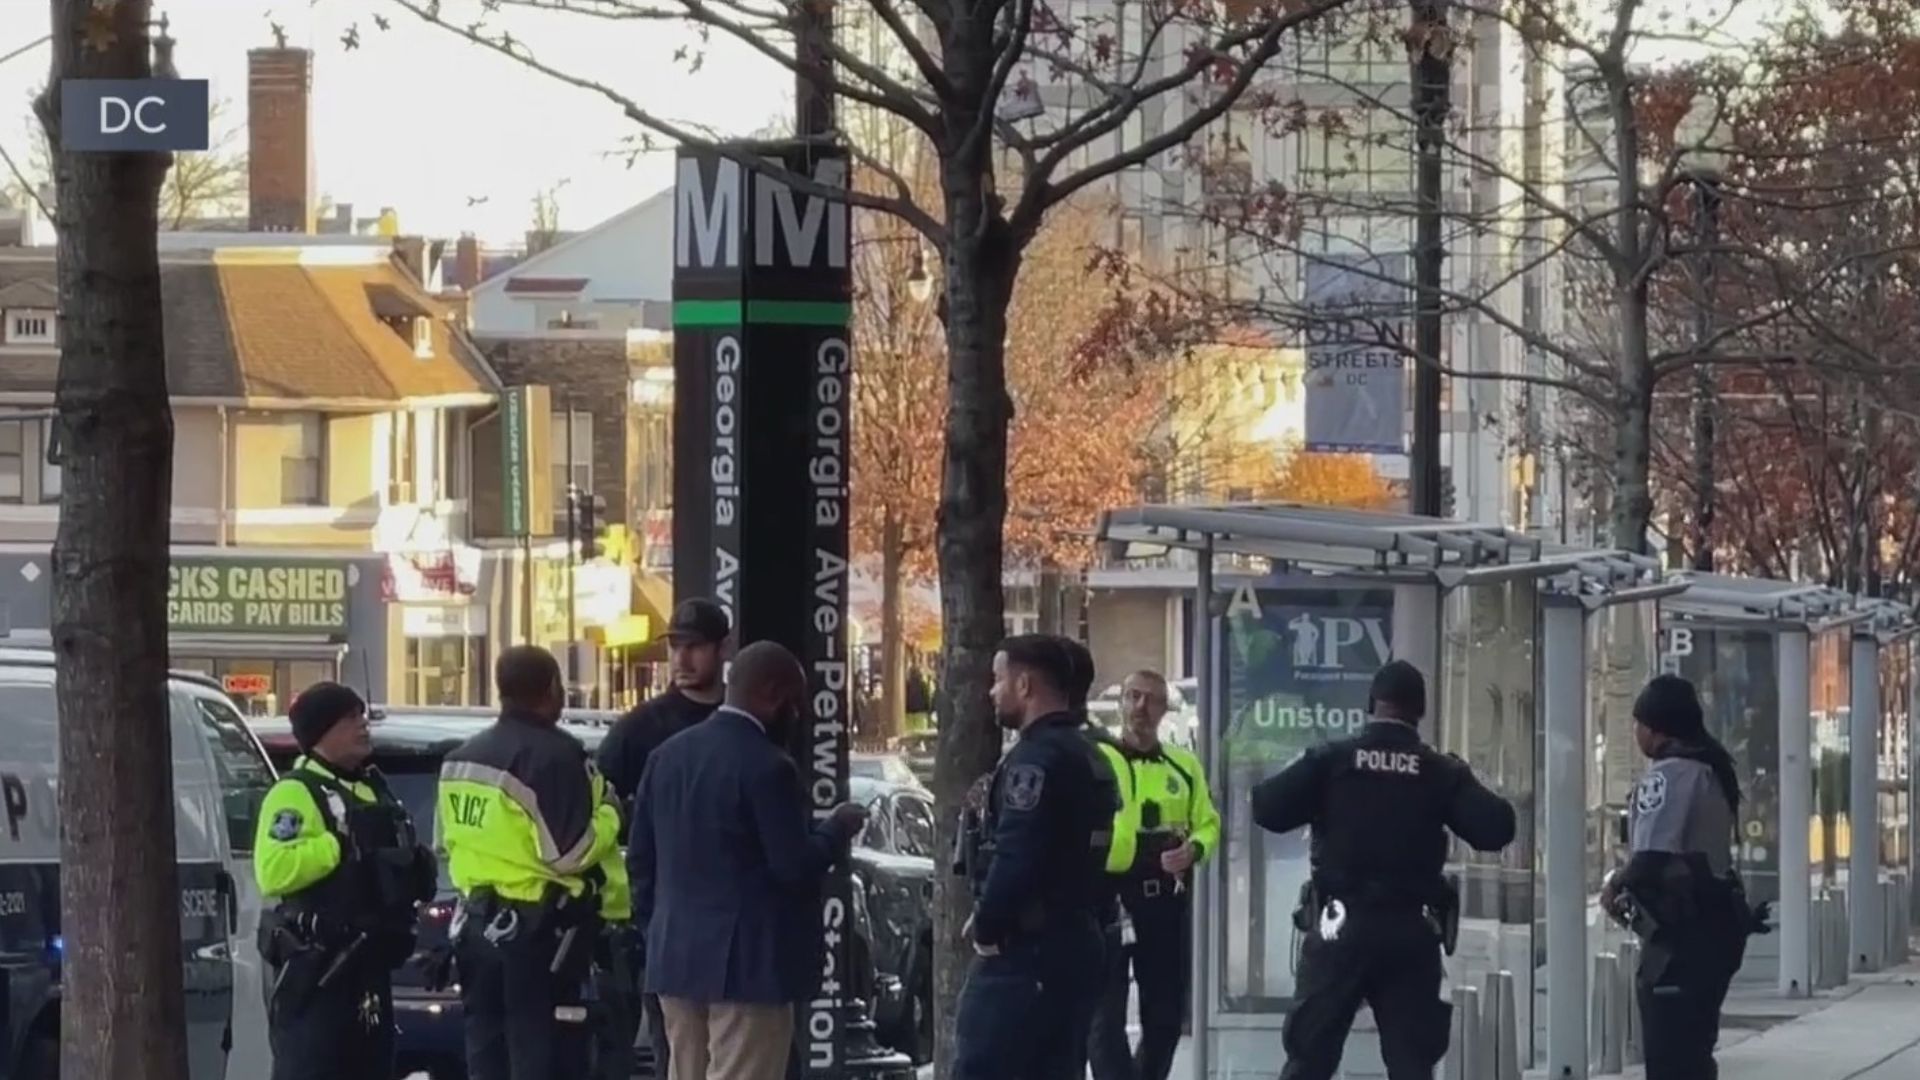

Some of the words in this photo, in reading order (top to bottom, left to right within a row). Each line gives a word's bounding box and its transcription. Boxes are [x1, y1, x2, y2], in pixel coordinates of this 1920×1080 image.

[677, 156, 739, 267] M
[755, 156, 846, 267] M
[1308, 352, 1405, 370] STREETS
[1346, 373, 1368, 387] DC
[711, 336, 741, 526] Georgia
[809, 338, 849, 526] Georgia
[167, 565, 219, 599] CKS
[227, 566, 345, 600] CASHED
[245, 602, 283, 625] PAY
[288, 603, 345, 626] BILLS
[1226, 584, 1263, 619] A
[1319, 616, 1393, 669] PV
[1670, 627, 1694, 656] B
[1254, 699, 1364, 735] Unstop
[1355, 749, 1420, 775] POLICE
